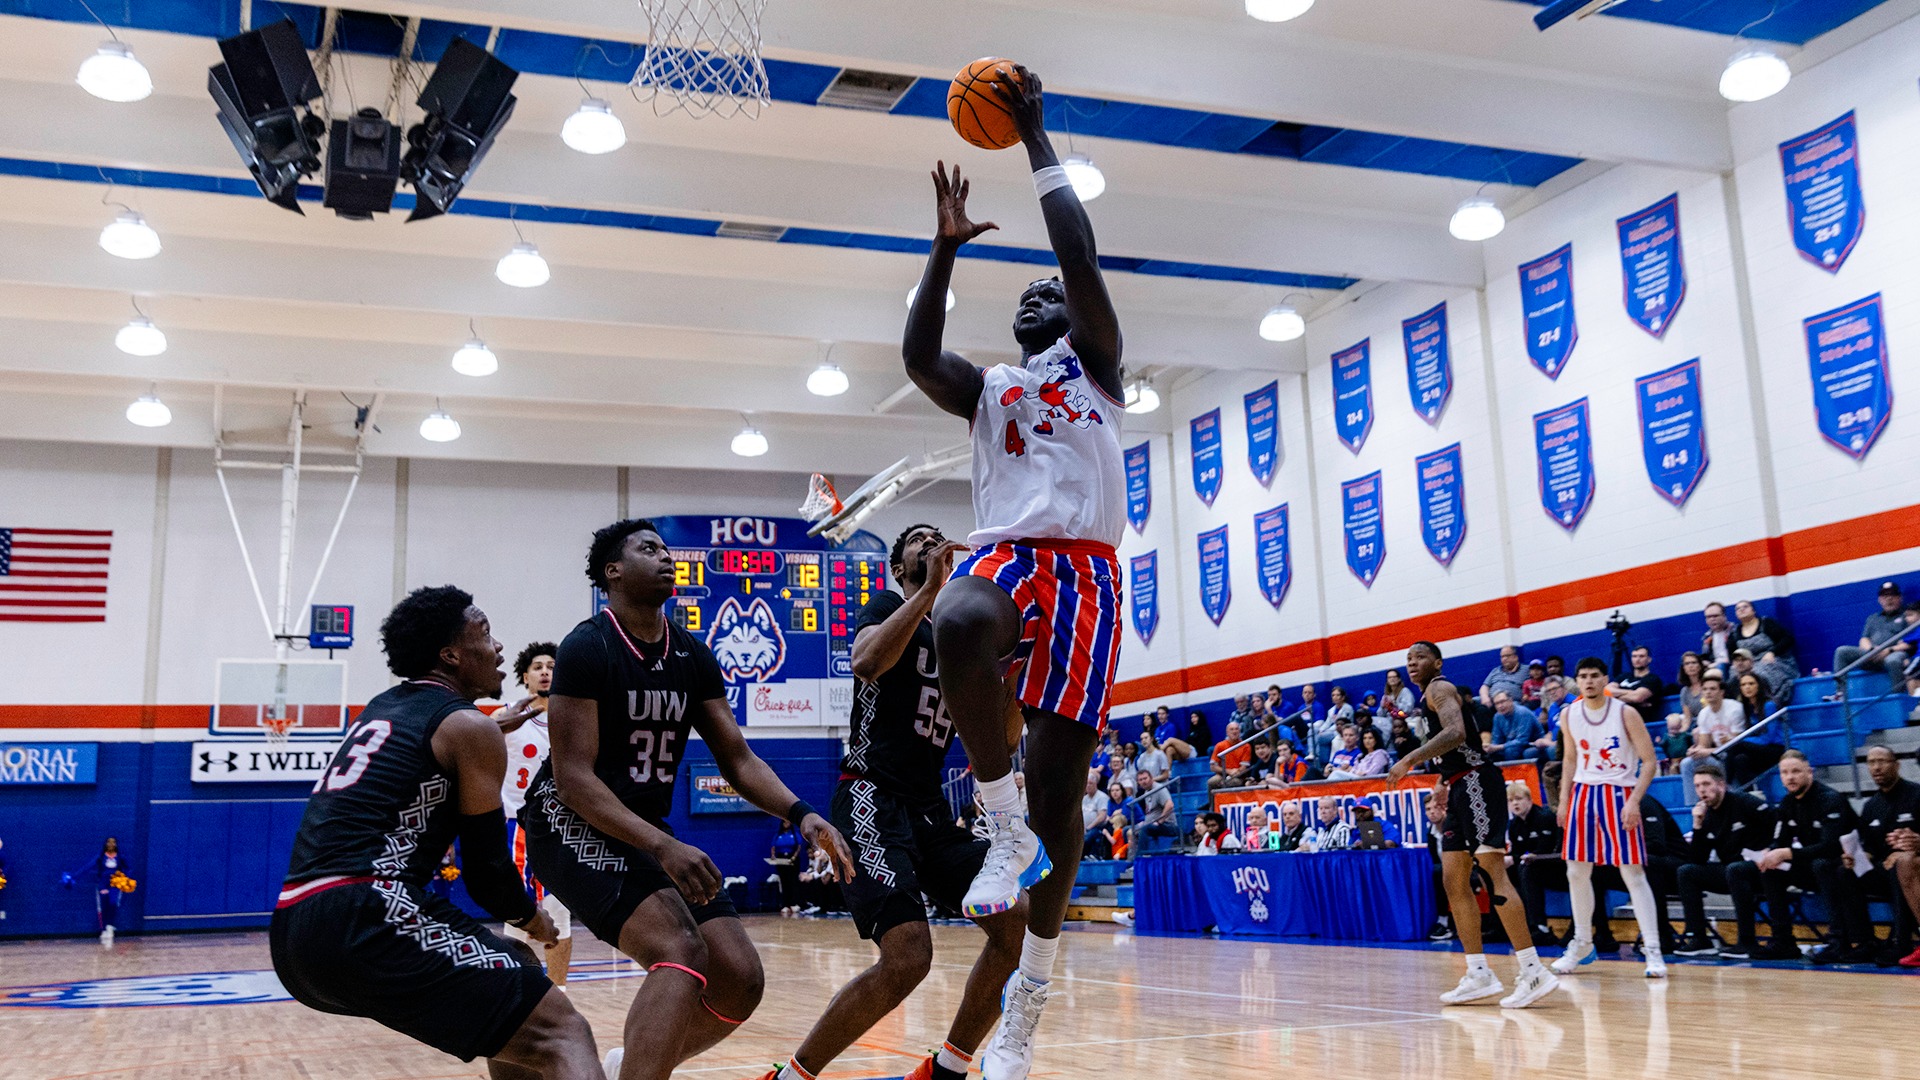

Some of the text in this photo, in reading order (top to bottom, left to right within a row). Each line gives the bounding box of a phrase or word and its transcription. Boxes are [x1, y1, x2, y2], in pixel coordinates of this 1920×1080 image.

[1005, 418, 1027, 458] 4
[710, 516, 777, 547] HCU
[667, 550, 707, 561] USKIES
[723, 550, 776, 574] 10:59
[785, 553, 820, 565] VISITOR
[675, 561, 704, 586] 21
[799, 564, 820, 588] 12
[745, 577, 752, 595] 1
[333, 607, 350, 635] 7
[686, 606, 701, 630] 3
[803, 608, 817, 632] 8
[627, 689, 687, 722] UIW
[913, 685, 952, 749] 55
[0, 746, 78, 768] ORIAL
[250, 752, 260, 770] I
[628, 729, 676, 783] 35
[516, 767, 530, 789] 3
[698, 778, 731, 790] FIRE
[1231, 866, 1270, 894] HCU
